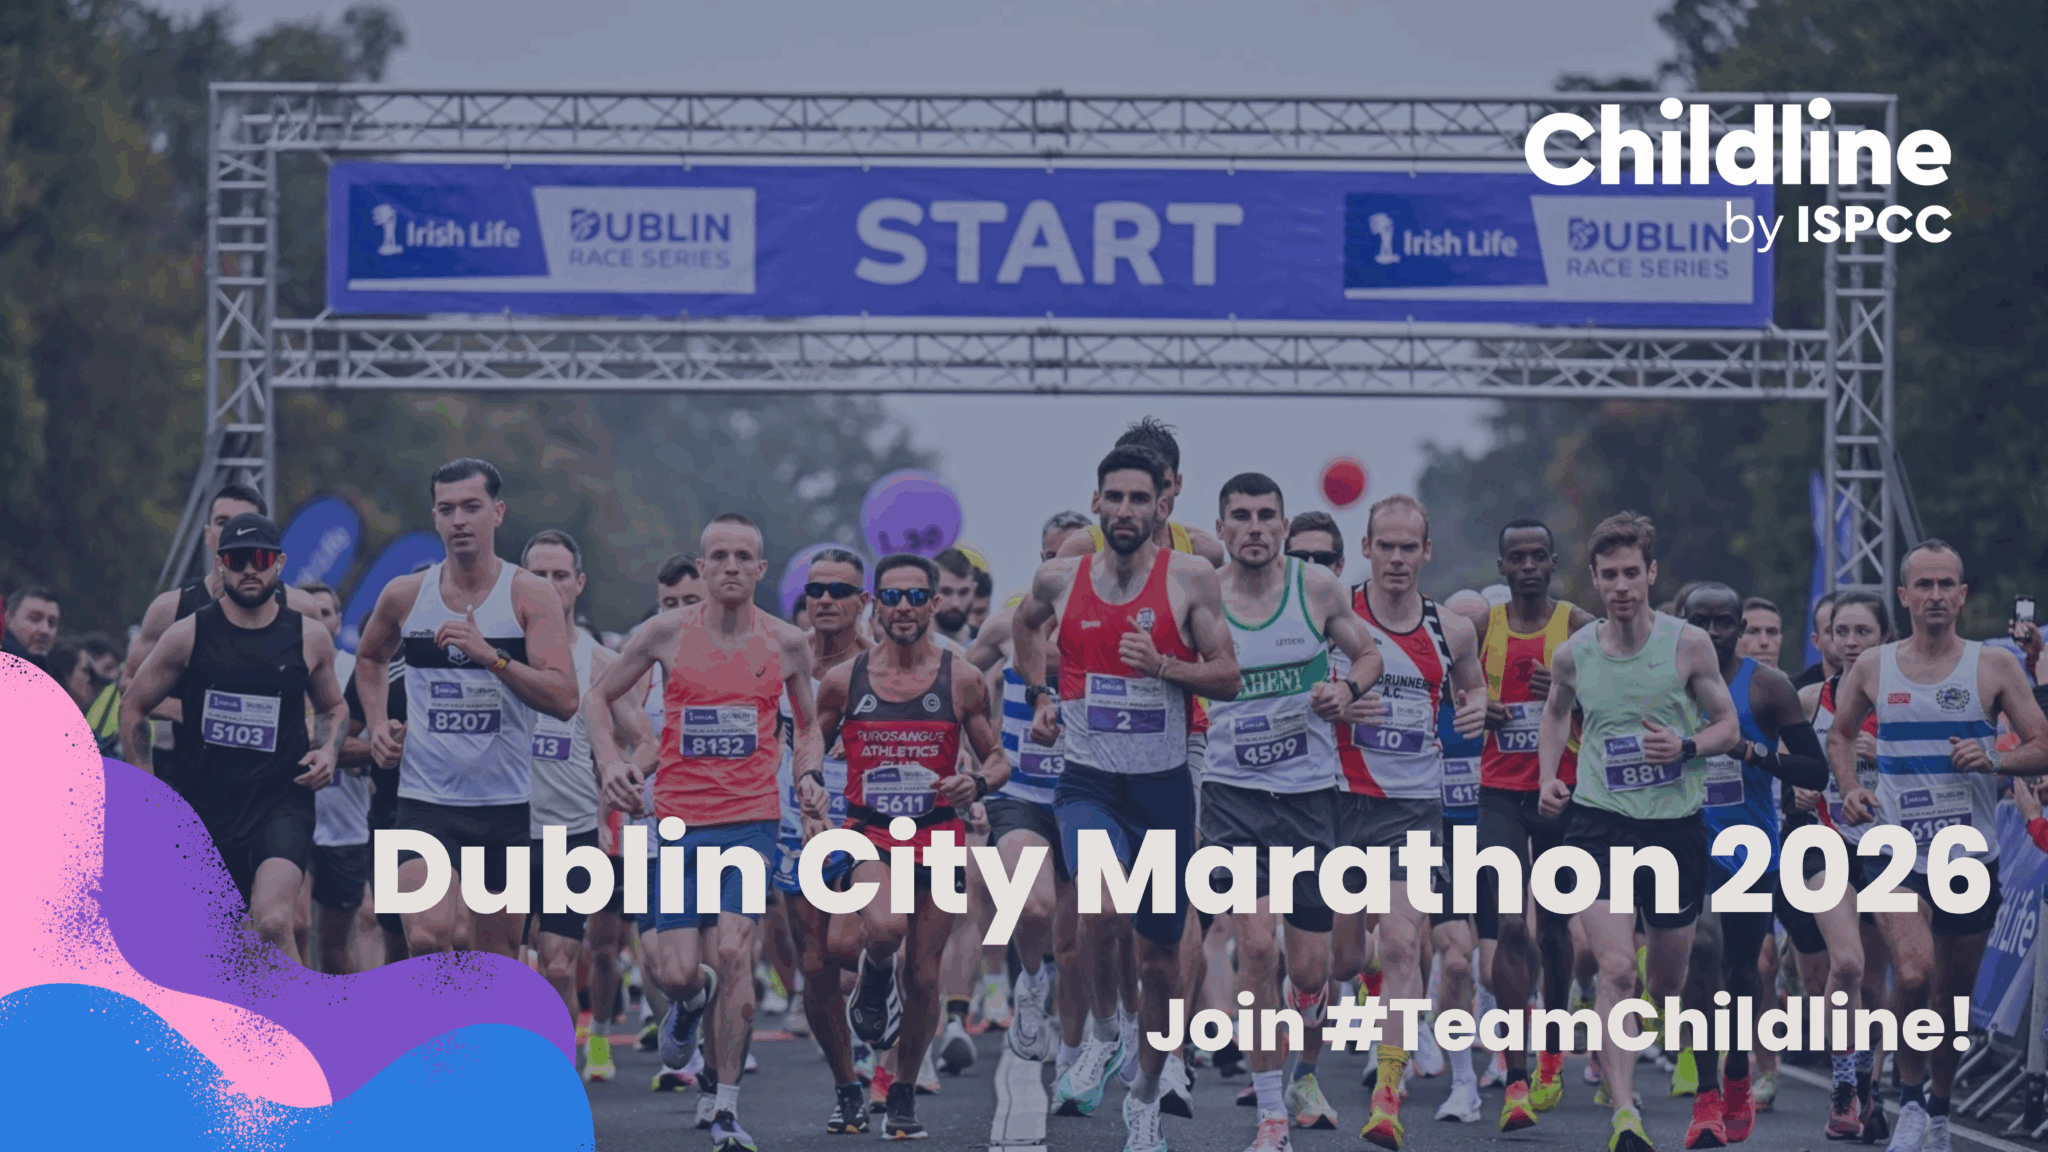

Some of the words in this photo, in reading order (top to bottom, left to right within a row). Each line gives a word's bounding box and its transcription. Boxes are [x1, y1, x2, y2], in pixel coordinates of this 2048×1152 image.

[406, 219, 465, 248] Irish
[469, 219, 521, 249] Life
[569, 207, 731, 243] DUBLIN
[1567, 216, 1731, 253] DUBLIN
[857, 199, 1243, 285] START
[1402, 228, 1463, 257] Irish
[1466, 228, 1519, 258] Life
[568, 248, 634, 268] RACE
[640, 249, 732, 269] SERIES
[1566, 256, 1633, 278] RACE
[1639, 257, 1730, 280] SERIES
[1239, 666, 1304, 698] AHENY
[1381, 685, 1404, 700] A.C.
[435, 712, 492, 731] 8207
[1116, 711, 1132, 731] 2
[210, 721, 265, 747] 5103
[857, 730, 947, 743] PUROSANGUE
[1376, 730, 1403, 748] 10
[533, 737, 560, 757] 13
[692, 737, 745, 755] 8132
[861, 745, 941, 758] ATHLETICS
[1243, 737, 1298, 765] 4599
[1622, 764, 1666, 785] 881
[876, 795, 924, 813] 5611
